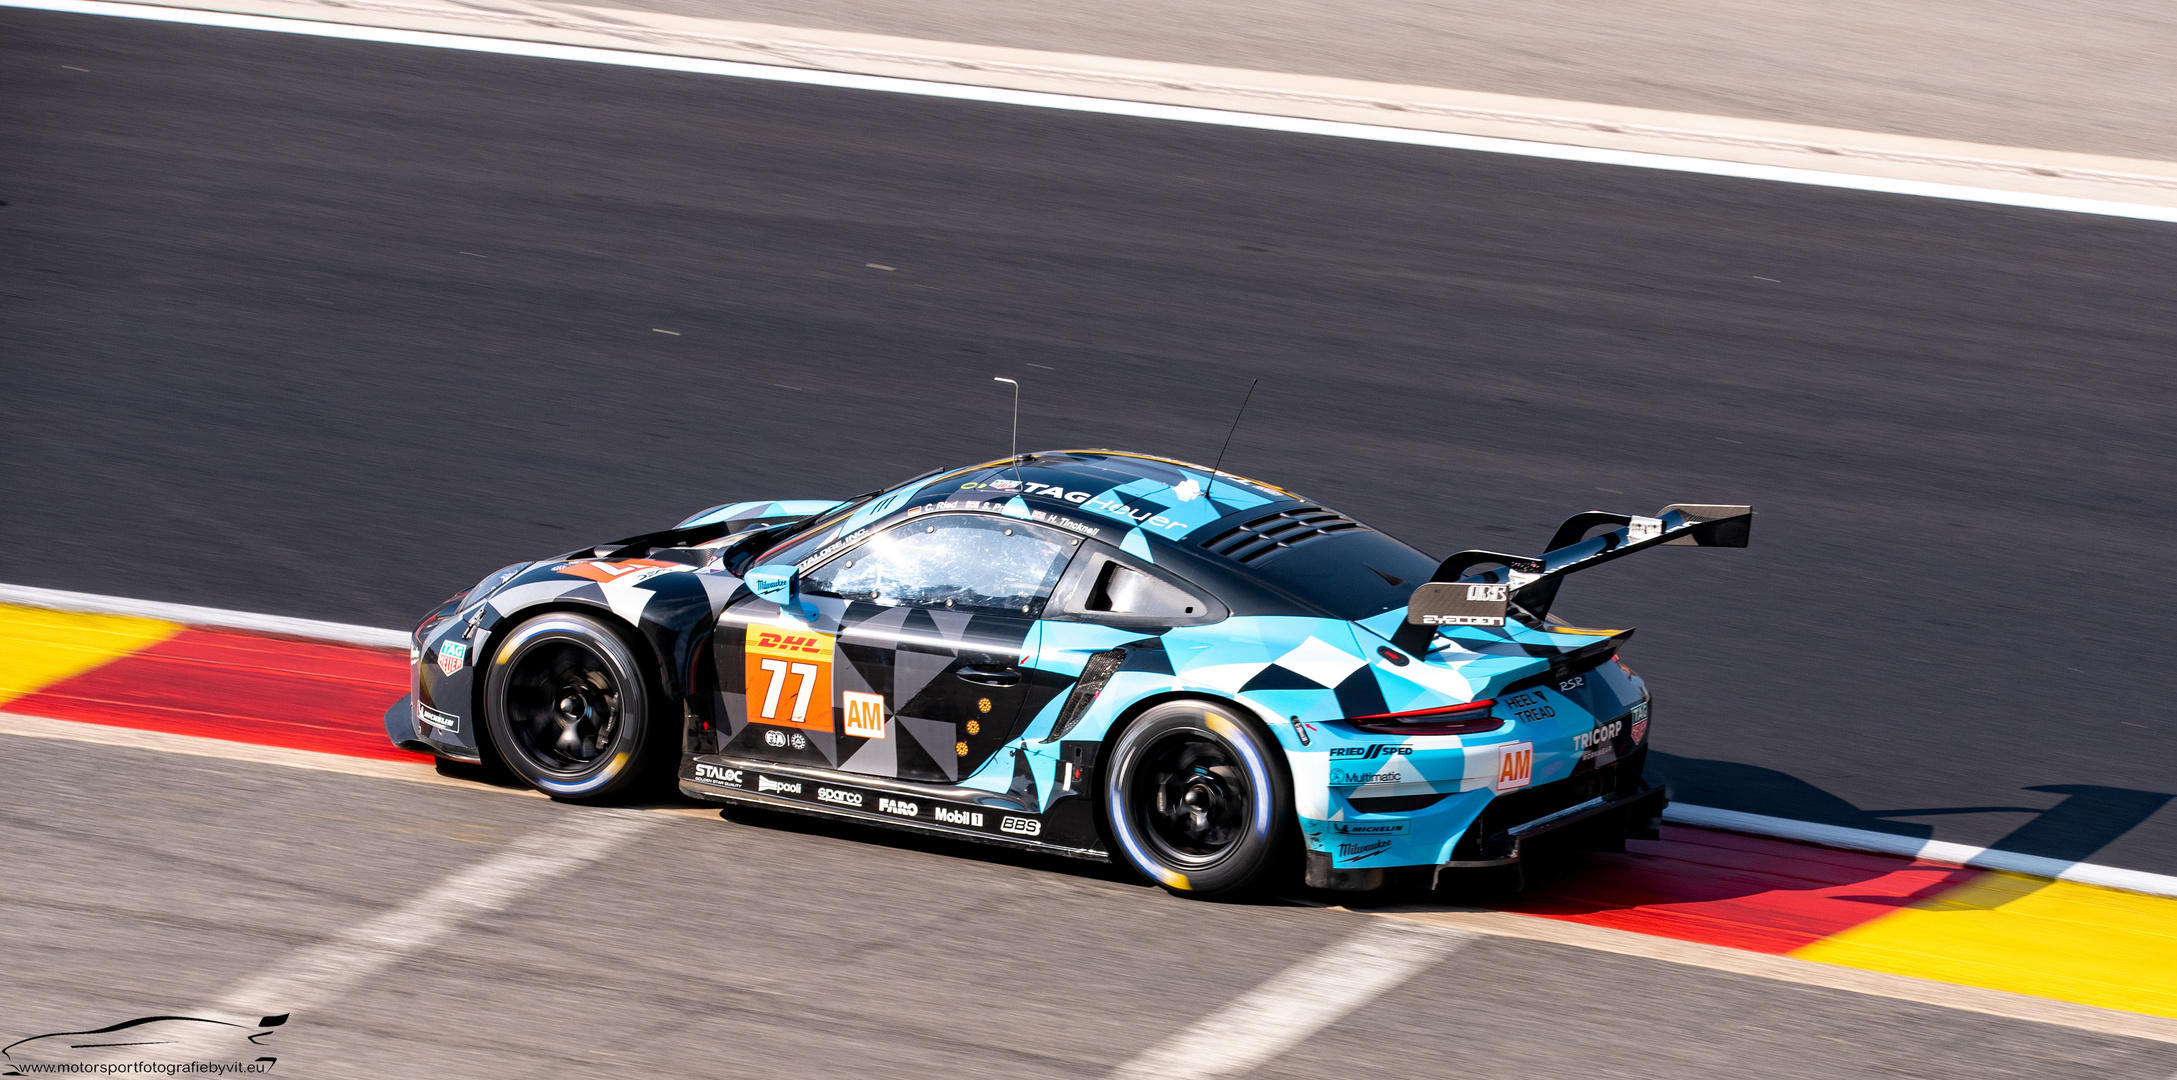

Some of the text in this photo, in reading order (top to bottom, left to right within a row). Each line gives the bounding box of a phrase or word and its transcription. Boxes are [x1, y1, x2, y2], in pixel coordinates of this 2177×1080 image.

[936, 500, 958, 510] Ried
[1059, 516, 1100, 536] Tincknell
[756, 579, 788, 592] Milwaukee
[443, 641, 465, 657] TAG
[758, 632, 820, 653] DHL
[439, 655, 462, 675] HEUER
[760, 657, 818, 723] 77
[1559, 676, 1584, 692] RSR
[1504, 692, 1537, 710] HEEL
[424, 710, 454, 727] MICHELIN
[847, 699, 882, 731] AM
[1515, 706, 1556, 723] TREAD
[1573, 720, 1622, 750] TRICORP
[1329, 747, 1413, 757] FRIED SPED
[695, 763, 743, 784] STALOC
[1499, 749, 1531, 784] AM
[1345, 771, 1401, 783] Multimatic
[777, 780, 801, 794] paoli
[818, 787, 863, 805] sparco
[878, 798, 918, 816] FARO
[935, 807, 970, 825] Mobil
[1002, 817, 1040, 834] BBS
[1351, 825, 1404, 833] MICHELIN
[1337, 839, 1392, 857] Milwaukee
